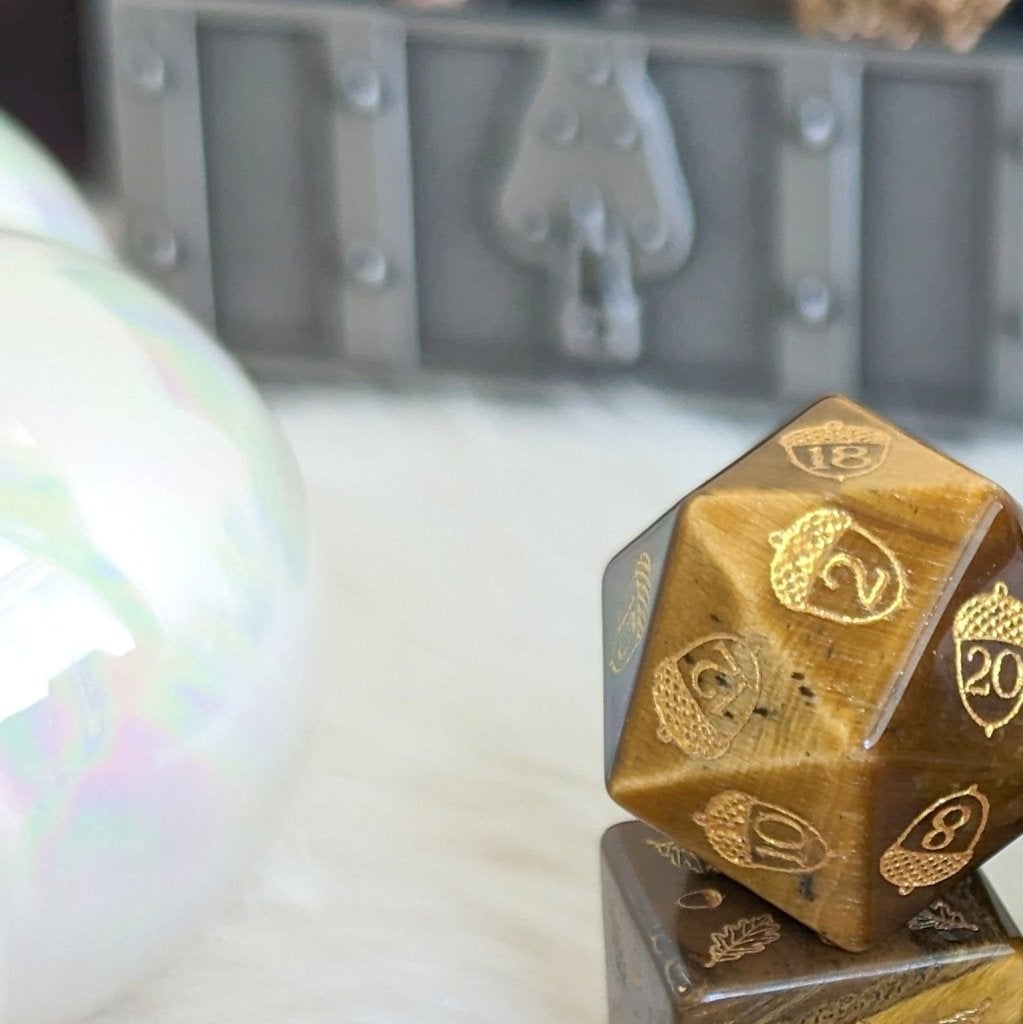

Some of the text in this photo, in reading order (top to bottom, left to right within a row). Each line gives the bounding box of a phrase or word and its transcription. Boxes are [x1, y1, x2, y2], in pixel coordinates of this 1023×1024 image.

[805, 444, 874, 471] 18
[820, 554, 889, 611] 2
[921, 802, 971, 852] 8
